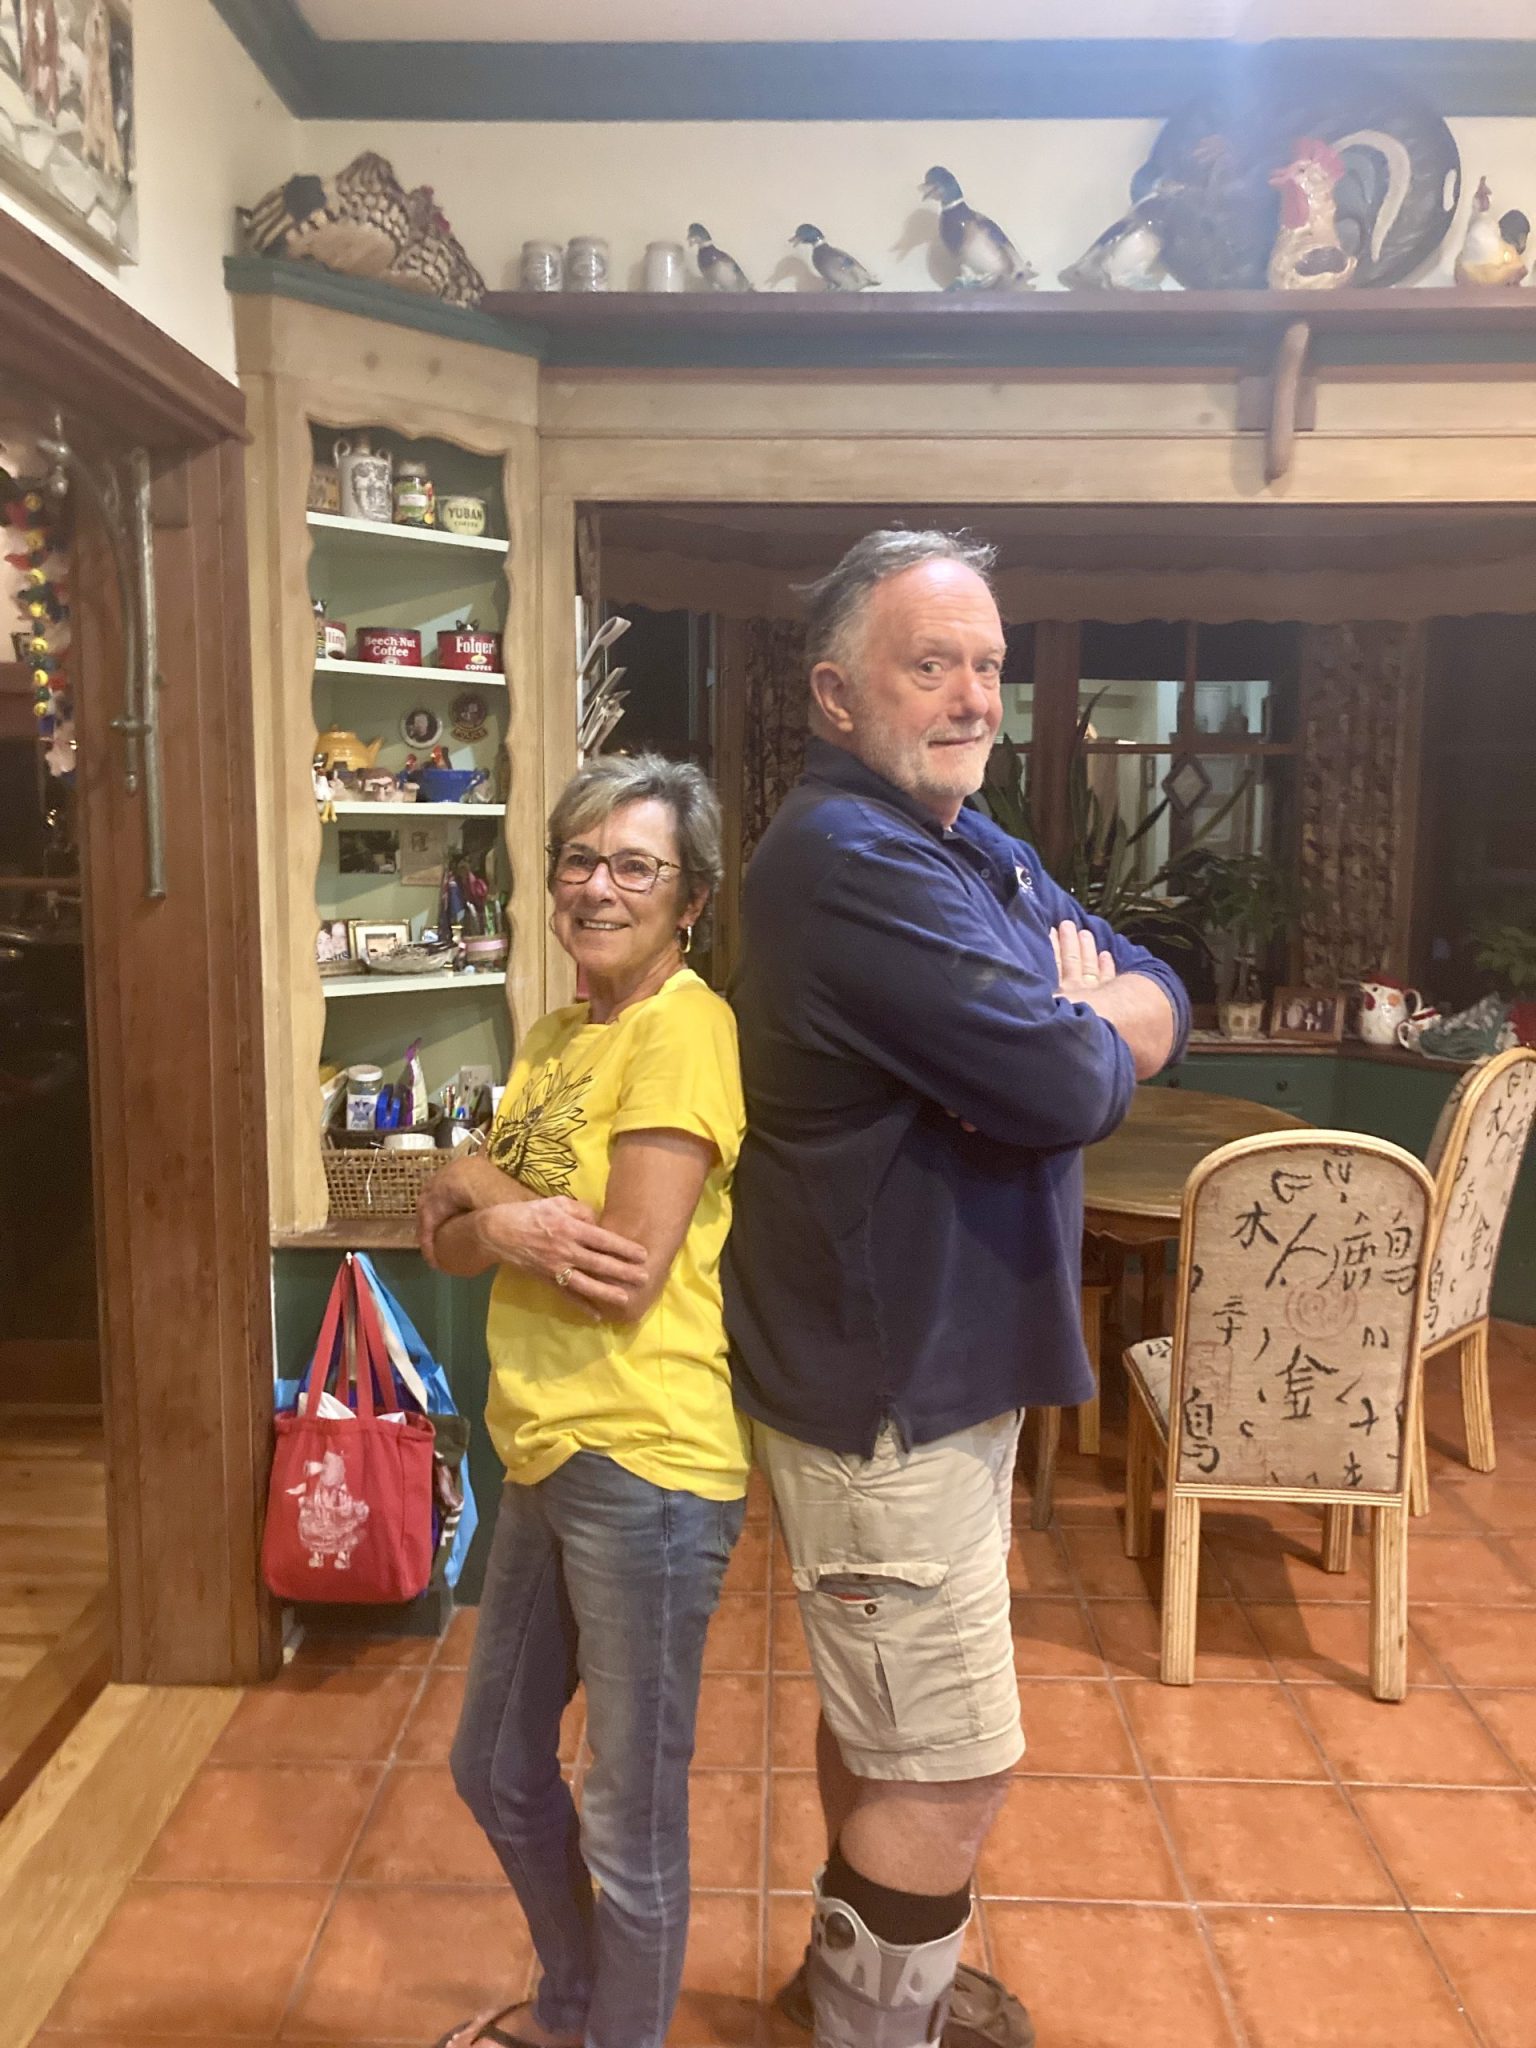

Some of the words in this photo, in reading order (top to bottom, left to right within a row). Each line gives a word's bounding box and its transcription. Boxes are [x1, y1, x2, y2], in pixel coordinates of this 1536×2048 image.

[447, 507, 483, 521] YUBAN
[363, 636, 416, 648] Beech-Nut
[372, 646, 409, 657] Coffee
[465, 664, 493, 672] COFFEE
